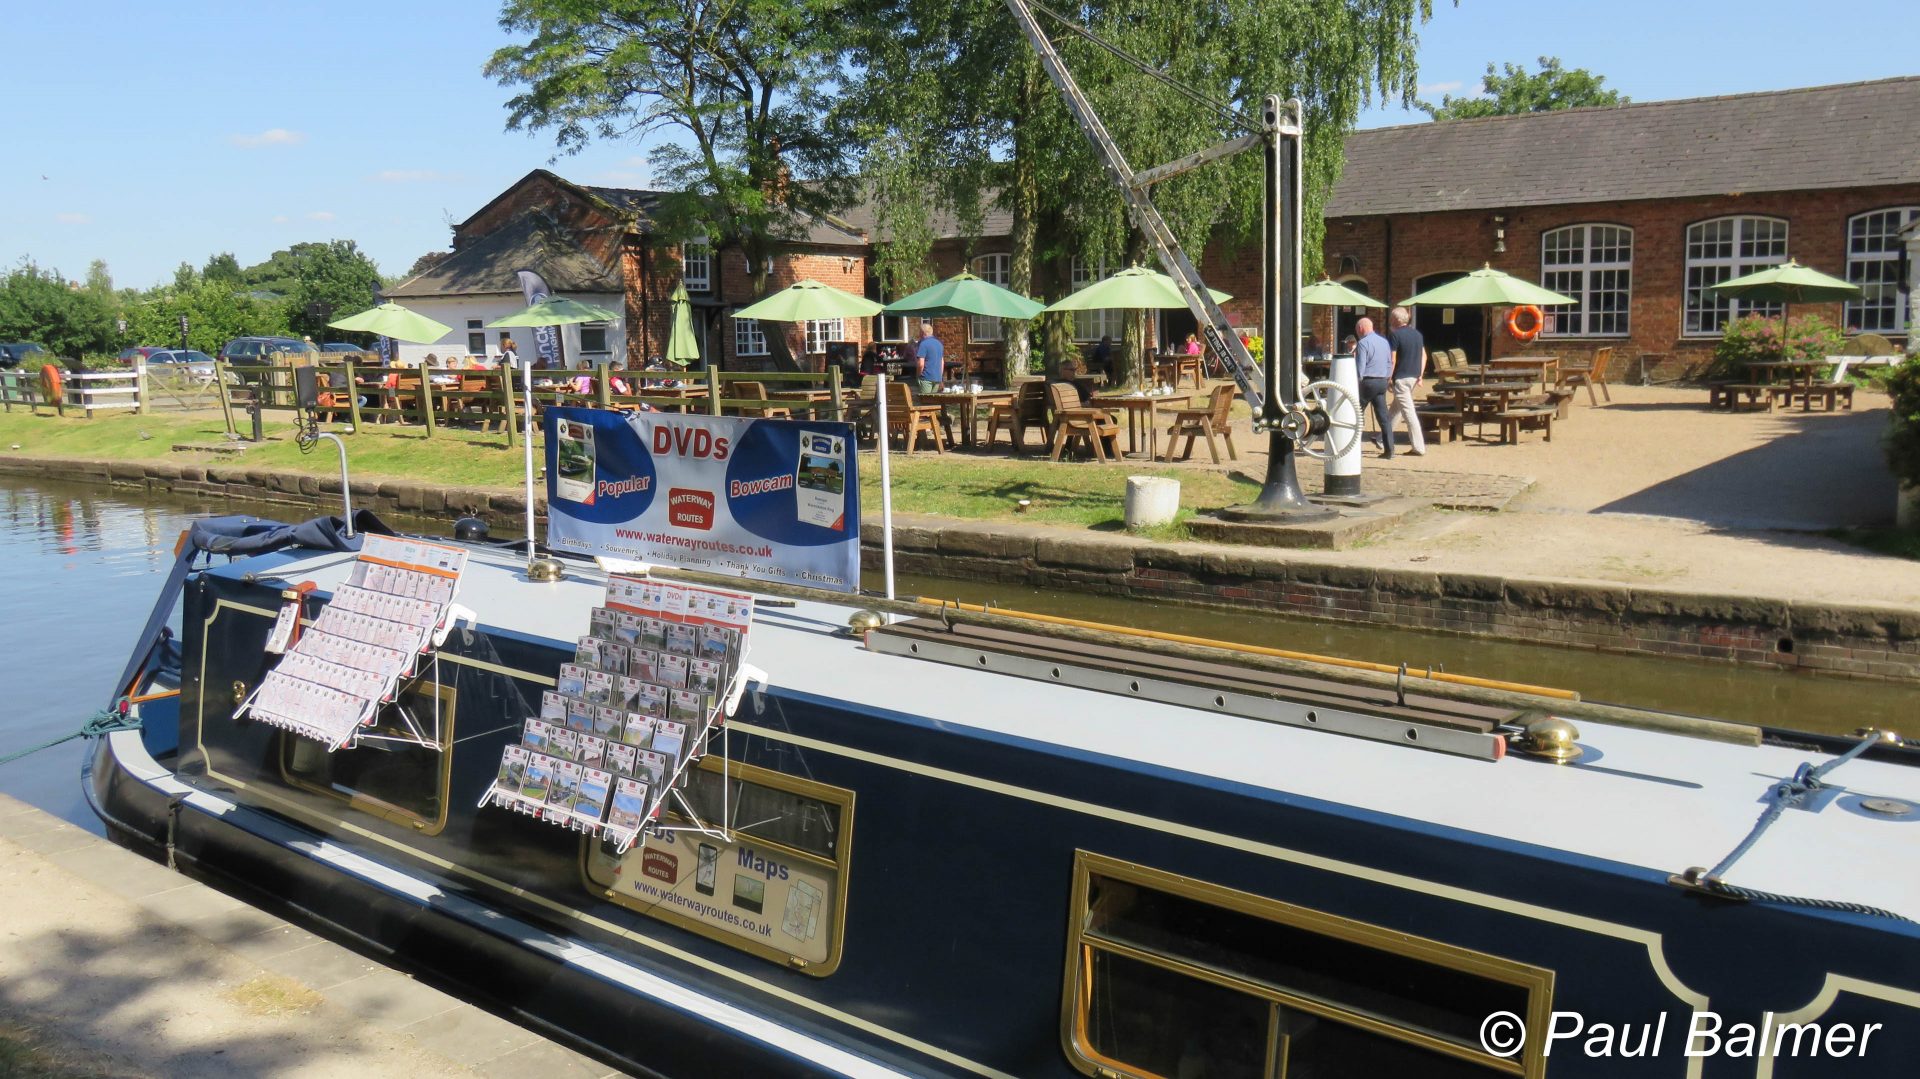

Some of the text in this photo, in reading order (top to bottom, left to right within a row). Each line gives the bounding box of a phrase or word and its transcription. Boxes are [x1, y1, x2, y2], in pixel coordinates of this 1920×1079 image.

[653, 425, 729, 460] DVDs
[598, 476, 650, 497] Popular
[730, 474, 792, 498] Bowcam
[670, 494, 712, 510] WATERWAY
[677, 512, 704, 524] ROUTES
[616, 528, 772, 558] www.waterwayroutes.co.uk
[562, 538, 843, 585] Birthdays Souvenirs Holiday Planning Thank You Gifts Christmas
[644, 853, 677, 868] WATERWAY
[648, 866, 669, 878] ROUTES
[738, 846, 789, 880] Maps
[634, 880, 772, 938] www.waterwayroutes.co.uk
